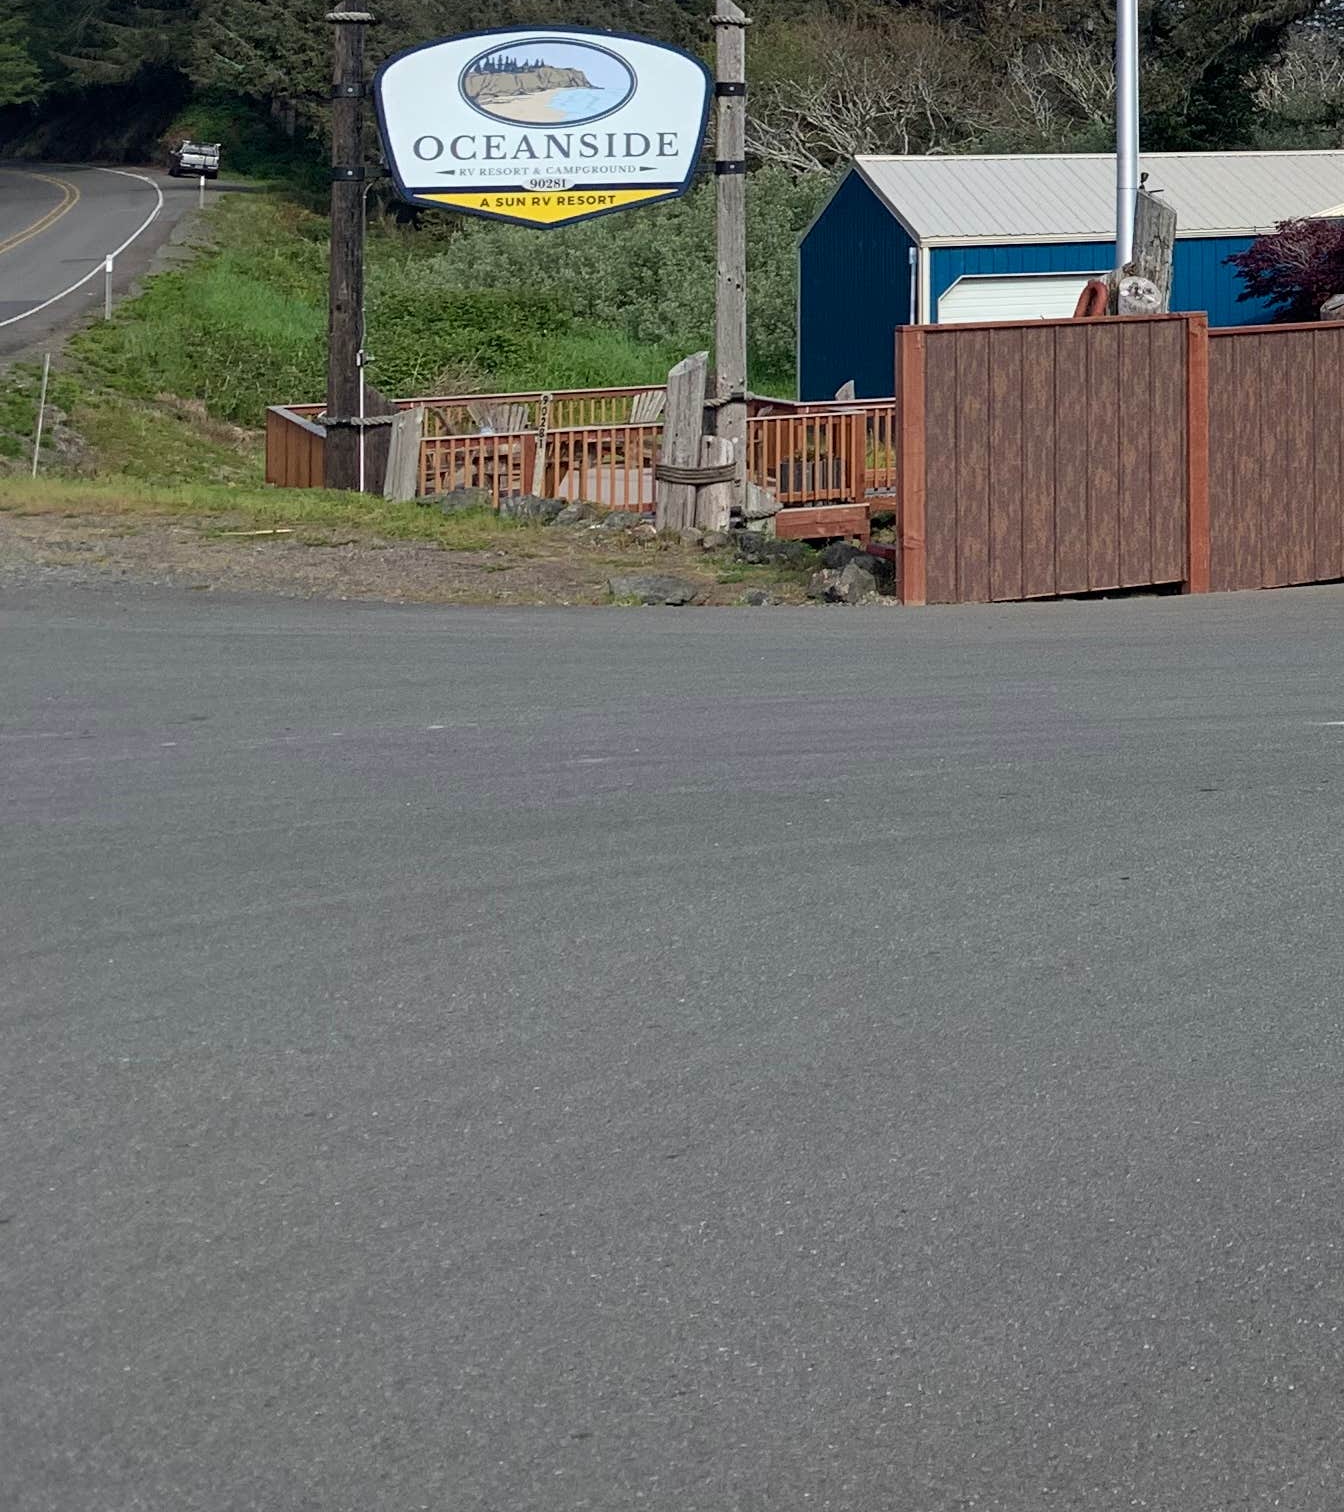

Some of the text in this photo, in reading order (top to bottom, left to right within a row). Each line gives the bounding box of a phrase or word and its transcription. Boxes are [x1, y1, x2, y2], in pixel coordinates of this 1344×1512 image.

[413, 132, 680, 161] OCEANSIDE
[459, 165, 636, 176] RV RESORT & CAMPGROUND
[529, 178, 567, 189] 90281
[480, 195, 616, 208] A SUN RV RESORT
[538, 395, 549, 449] 90281
